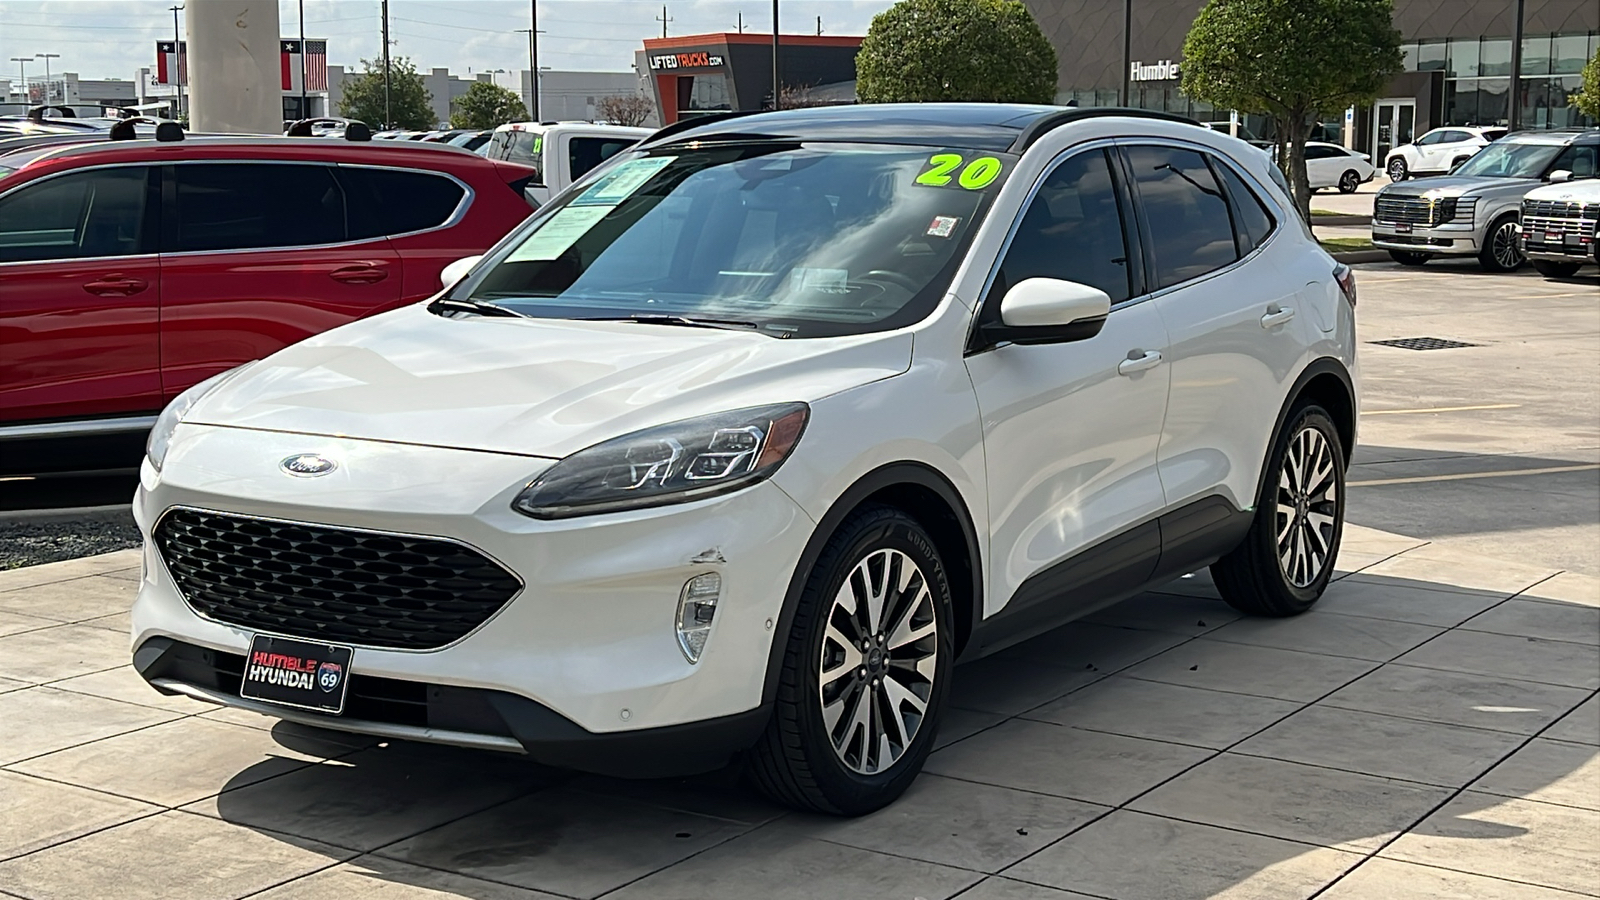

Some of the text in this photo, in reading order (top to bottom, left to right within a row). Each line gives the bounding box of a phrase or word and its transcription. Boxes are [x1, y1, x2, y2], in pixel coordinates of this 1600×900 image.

[1130, 60, 1180, 81] Humble
[915, 153, 1003, 190] 20
[252, 651, 318, 674] HUMBLE
[248, 664, 316, 691] HYUNDAI
[320, 673, 338, 688] 69
